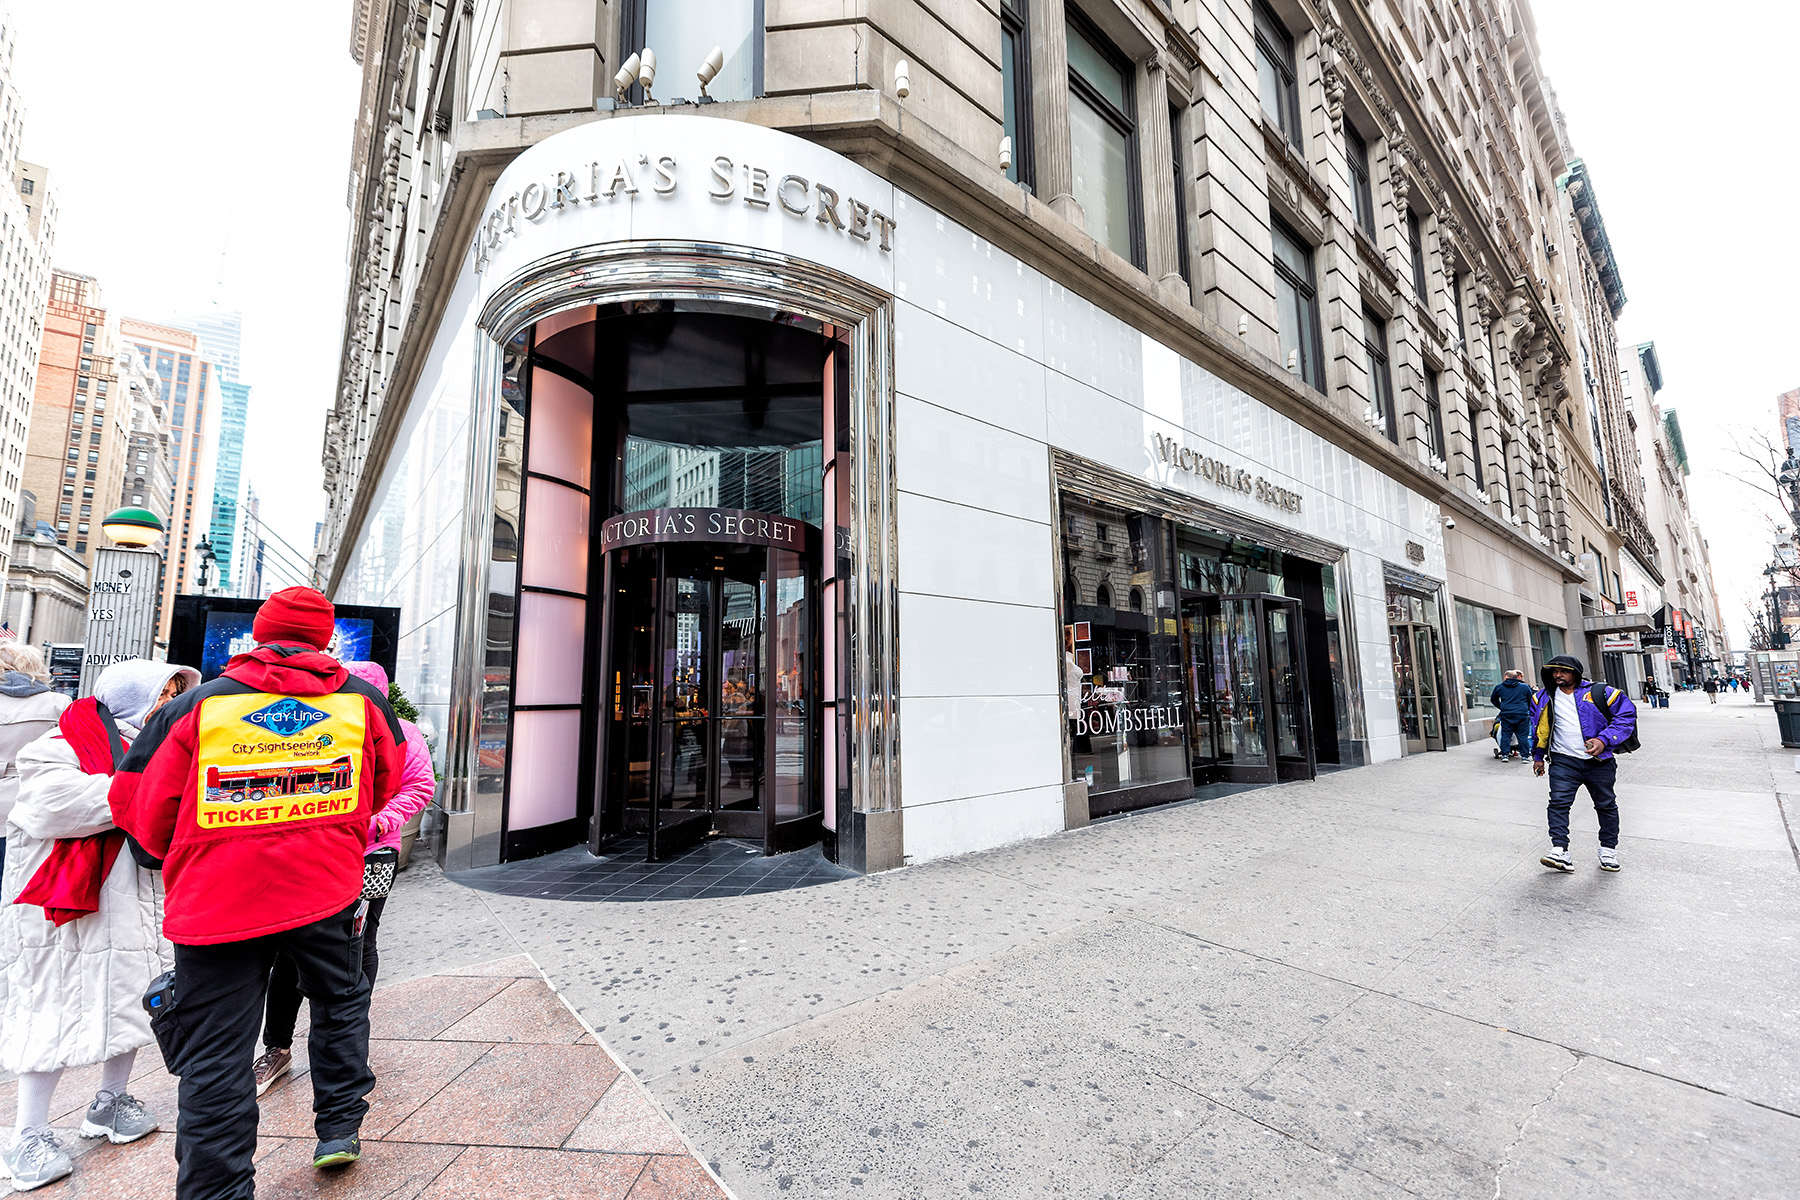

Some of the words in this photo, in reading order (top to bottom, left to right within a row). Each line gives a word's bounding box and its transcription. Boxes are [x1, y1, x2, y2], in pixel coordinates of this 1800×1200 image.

[474, 154, 677, 274] VICTORIA'S
[708, 156, 896, 252] SECRET
[1156, 432, 1252, 494] VICTORIA'S
[1255, 476, 1302, 513] SECRET
[708, 513, 796, 543] SECRET
[94, 581, 131, 593] MONEY
[92, 609, 113, 620] YES
[1076, 706, 1184, 736] BOMBSHELL
[232, 743, 255, 754] City
[258, 740, 323, 753] Sightseeing
[204, 806, 283, 824] TICKET
[288, 797, 352, 817] AGENT
